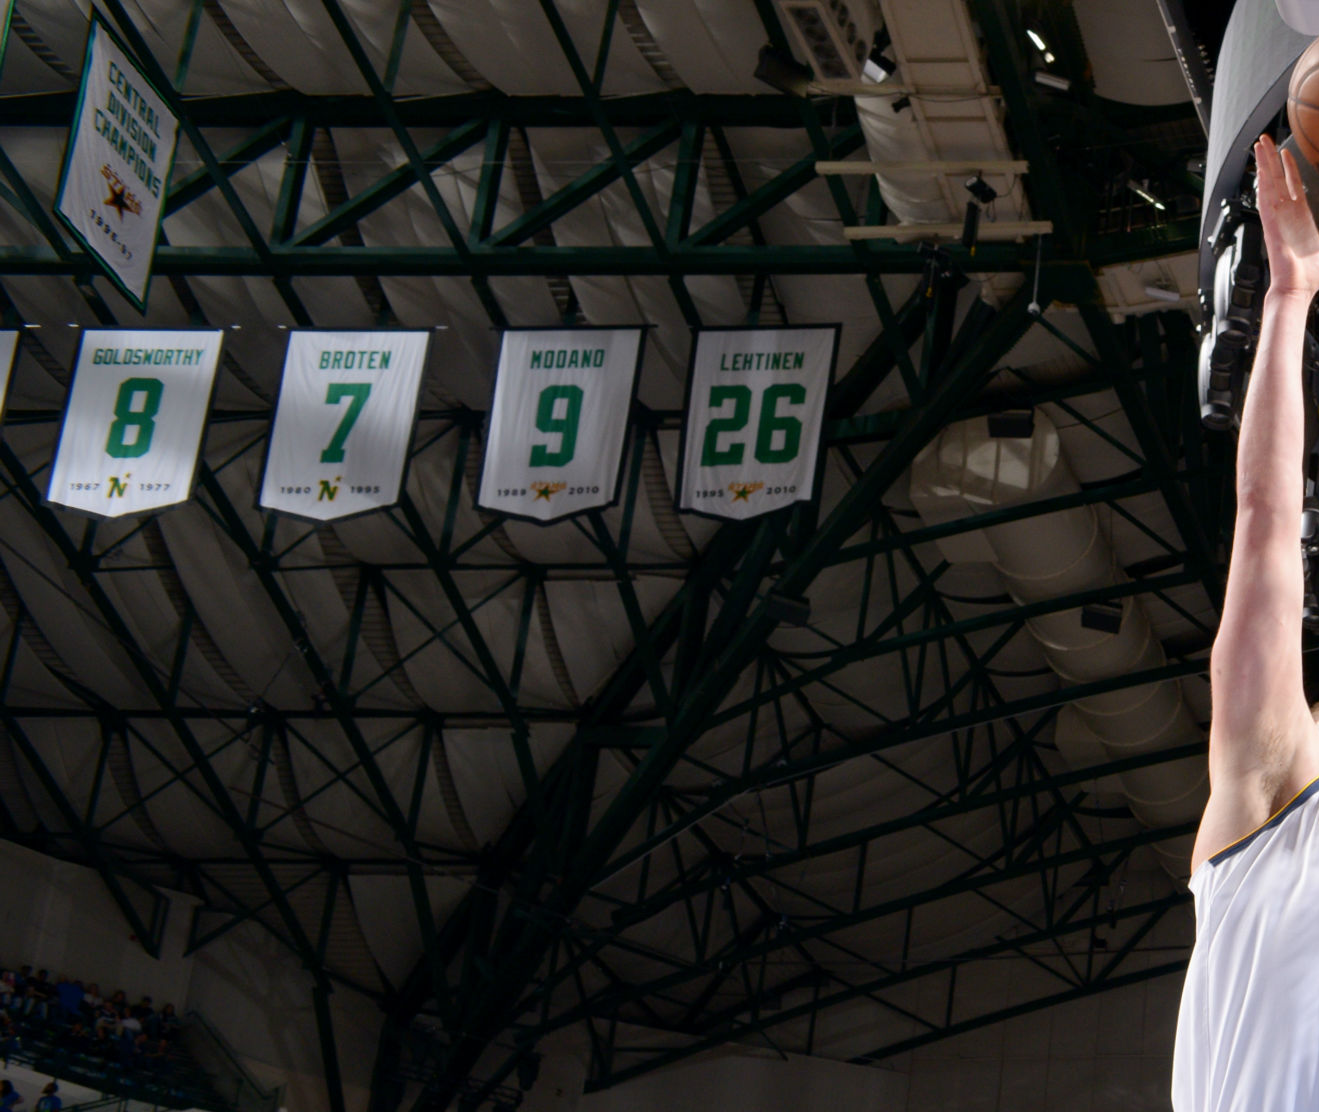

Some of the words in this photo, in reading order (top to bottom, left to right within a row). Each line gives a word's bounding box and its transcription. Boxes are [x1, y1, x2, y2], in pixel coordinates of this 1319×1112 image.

[107, 90, 157, 163] DIVISION
[108, 60, 161, 140] CENTRAL
[93, 108, 162, 200] CHAMPIONS
[92, 348, 205, 366] GOLDSWORTHY
[318, 350, 392, 370] BROTEN
[530, 348, 606, 369] MODANO
[720, 351, 805, 372] LEHTINEN
[105, 377, 165, 458] 8
[320, 382, 372, 464] 7
[528, 384, 584, 467] 9
[700, 383, 808, 467] 26
[568, 485, 600, 495] 2010
[765, 485, 797, 495] 2010
